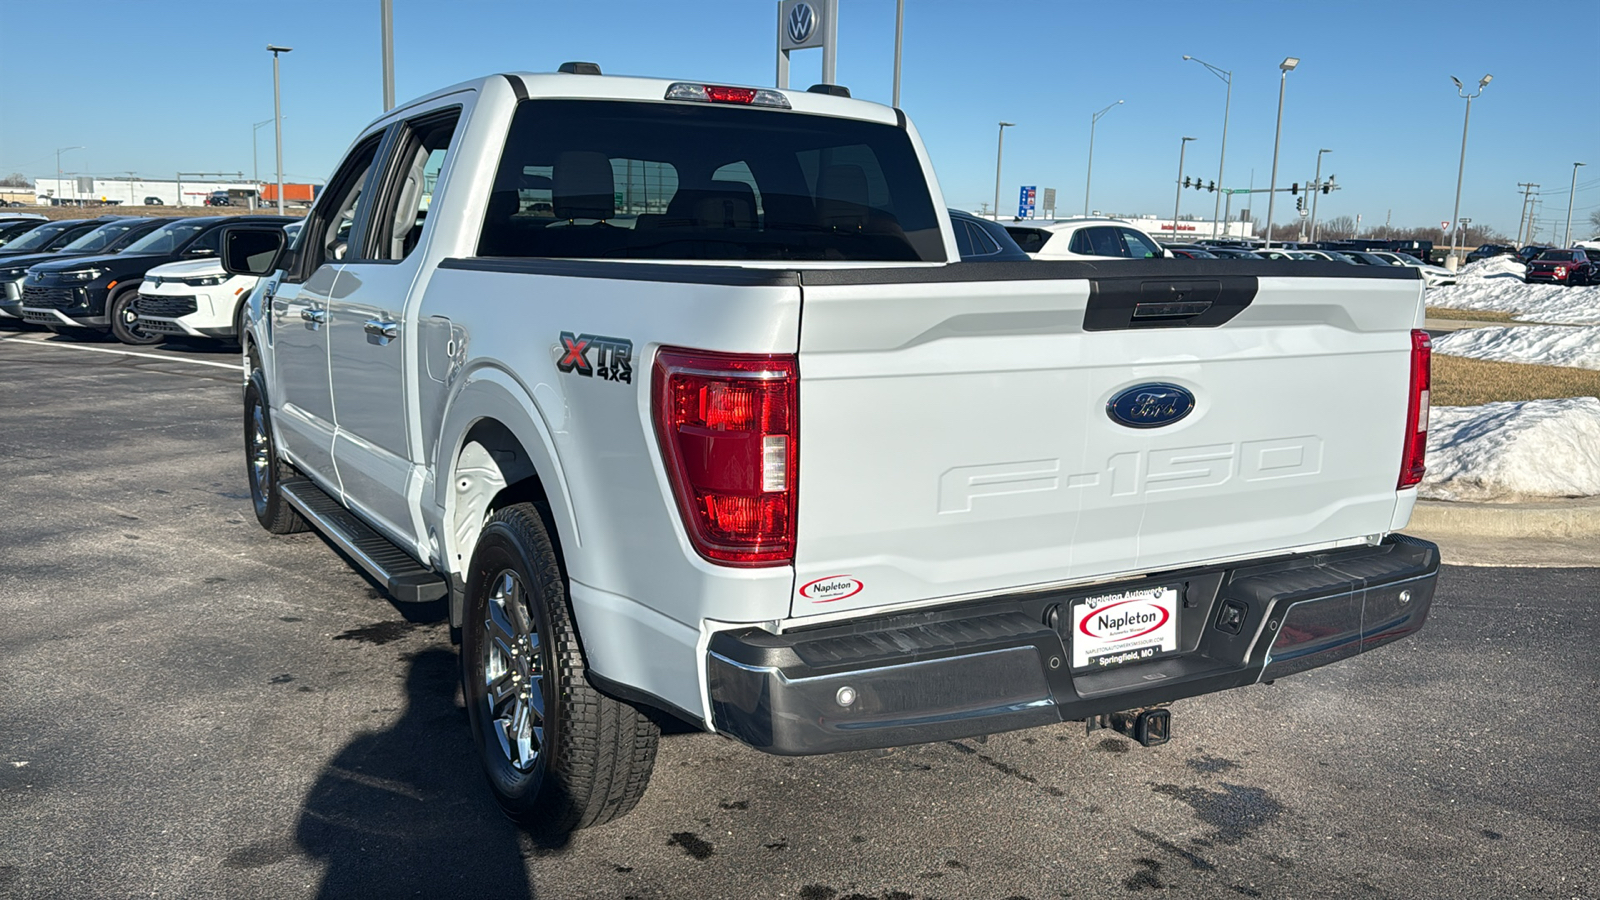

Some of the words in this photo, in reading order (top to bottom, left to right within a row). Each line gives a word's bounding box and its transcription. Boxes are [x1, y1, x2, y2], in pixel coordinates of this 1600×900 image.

[557, 331, 633, 377] XTR
[1131, 392, 1178, 418] Ford
[937, 434, 1323, 514] F-150
[813, 582, 851, 593] Napleton
[1085, 593, 1123, 605] Napleton
[1098, 611, 1156, 630] Napleton
[1141, 648, 1153, 658] MO
